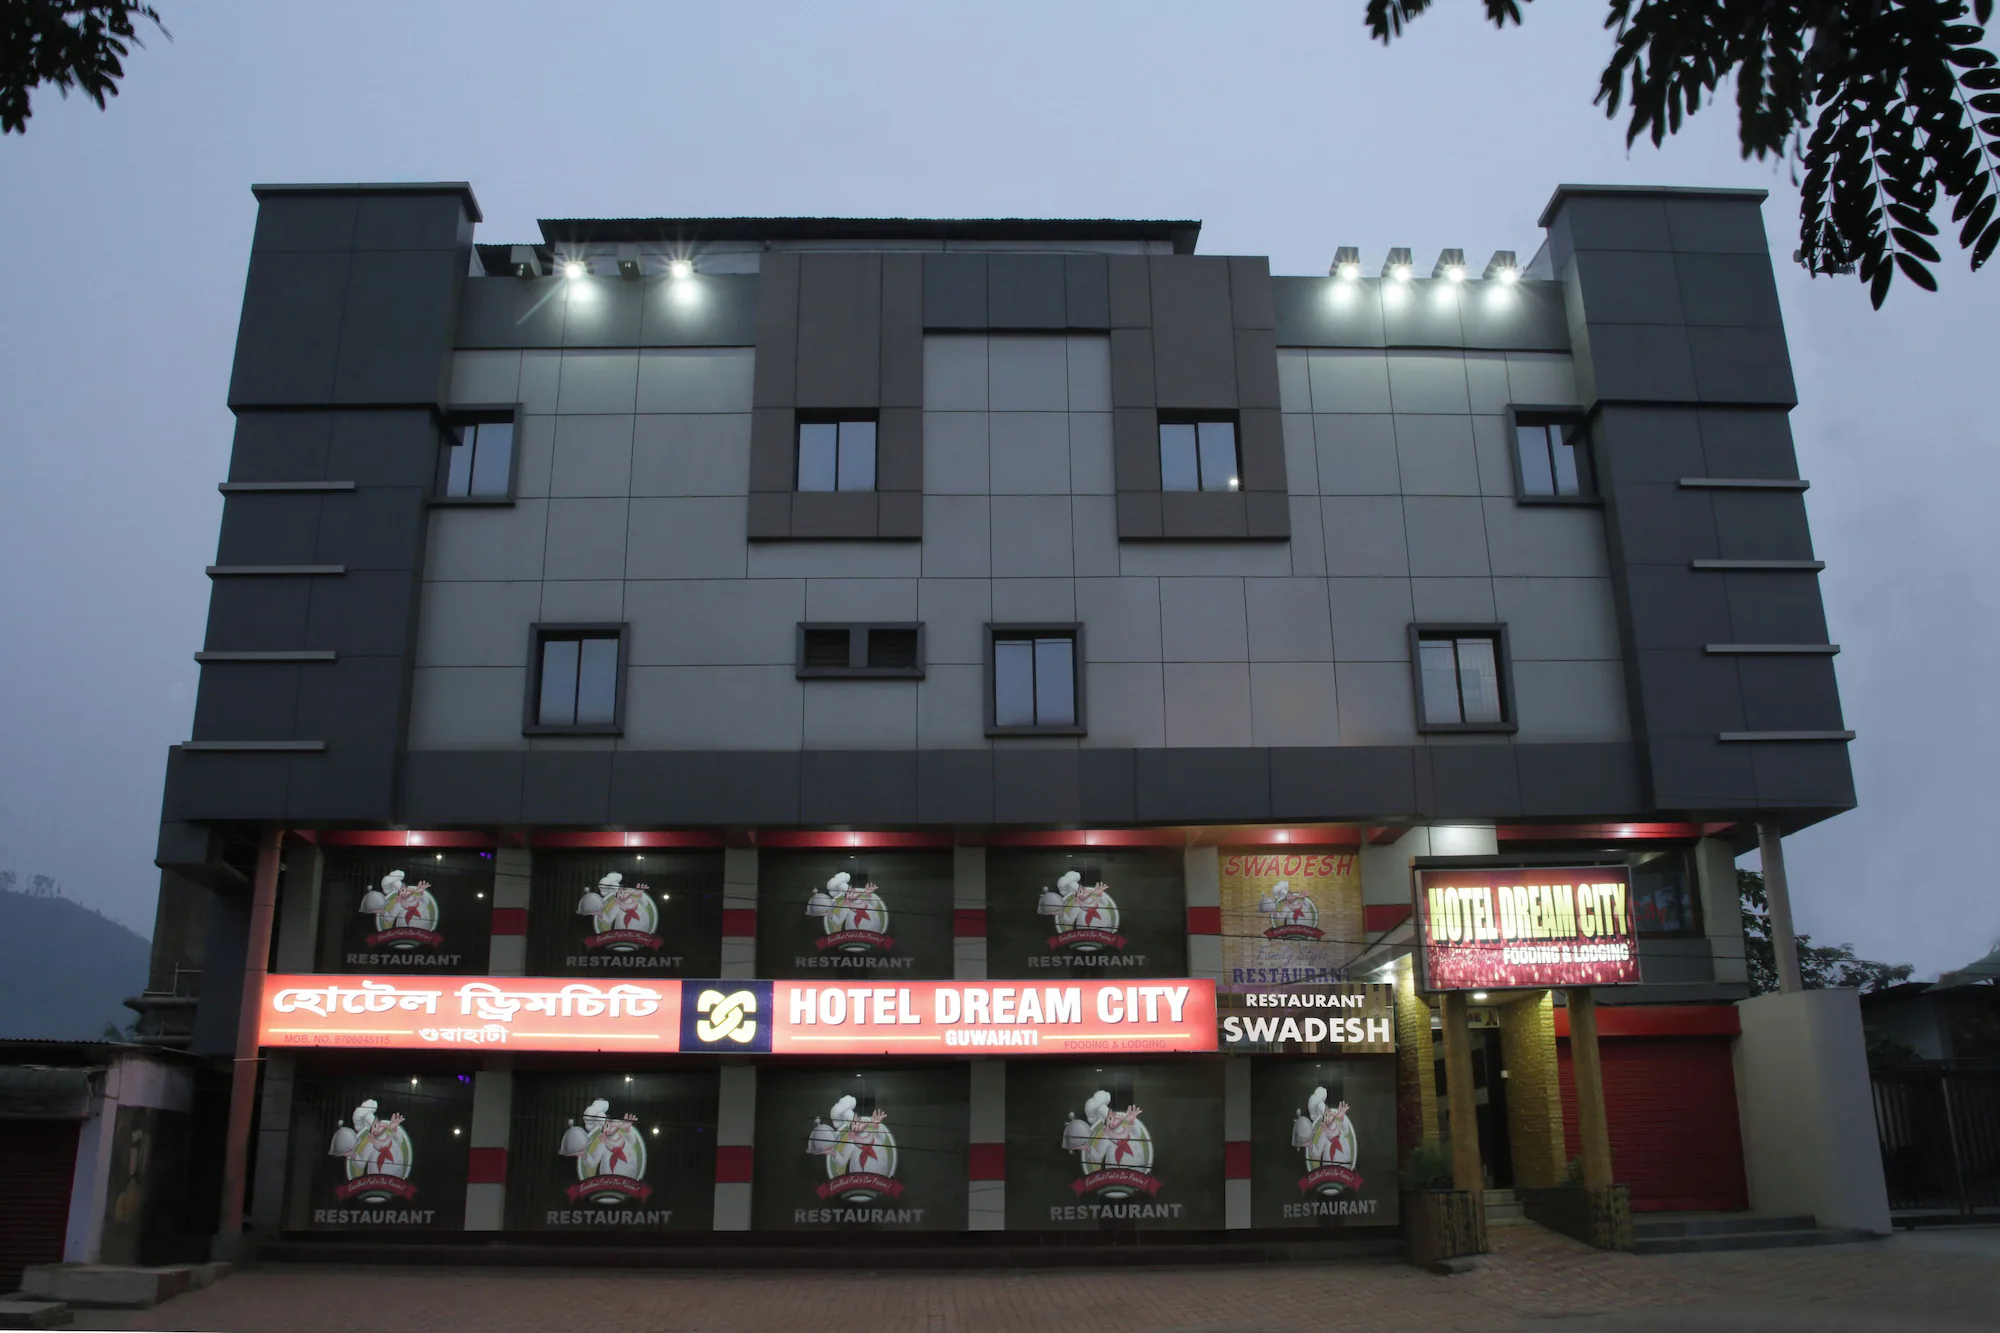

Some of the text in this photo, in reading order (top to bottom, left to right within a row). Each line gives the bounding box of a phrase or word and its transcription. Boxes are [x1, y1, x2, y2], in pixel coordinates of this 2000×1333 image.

[1224, 855, 1354, 878] SWADESH
[1428, 883, 1628, 941] HOTEL DREAM CITY
[346, 953, 461, 966] RESTAURANT
[566, 956, 683, 968] RESTAURANT
[795, 956, 914, 968] RESTAURANT
[1028, 955, 1145, 968] RESTAURANT
[1256, 945, 1328, 966] Family Style
[1503, 943, 1629, 965] FOODING & LODGING
[1233, 967, 1350, 984] RESTAURANT
[273, 980, 442, 1018] হোটেল
[790, 986, 1191, 1025] HOTEL DREAM CITY
[1246, 994, 1364, 1008] RESTAURANT
[1223, 1016, 1390, 1043] SWADESH
[284, 1034, 311, 1044] MOB.
[314, 1034, 332, 1044] NO.
[945, 1030, 1039, 1046] GUWAHATI
[1064, 1039, 1167, 1050] FOODING & LODGING
[314, 1209, 435, 1224] RESTAURANT
[795, 1208, 924, 1224] RESTAURANT
[1050, 1204, 1182, 1220] RESTAURANT
[1283, 1200, 1377, 1218] RESTAURANT
[546, 1210, 673, 1225] RESTAURANT
